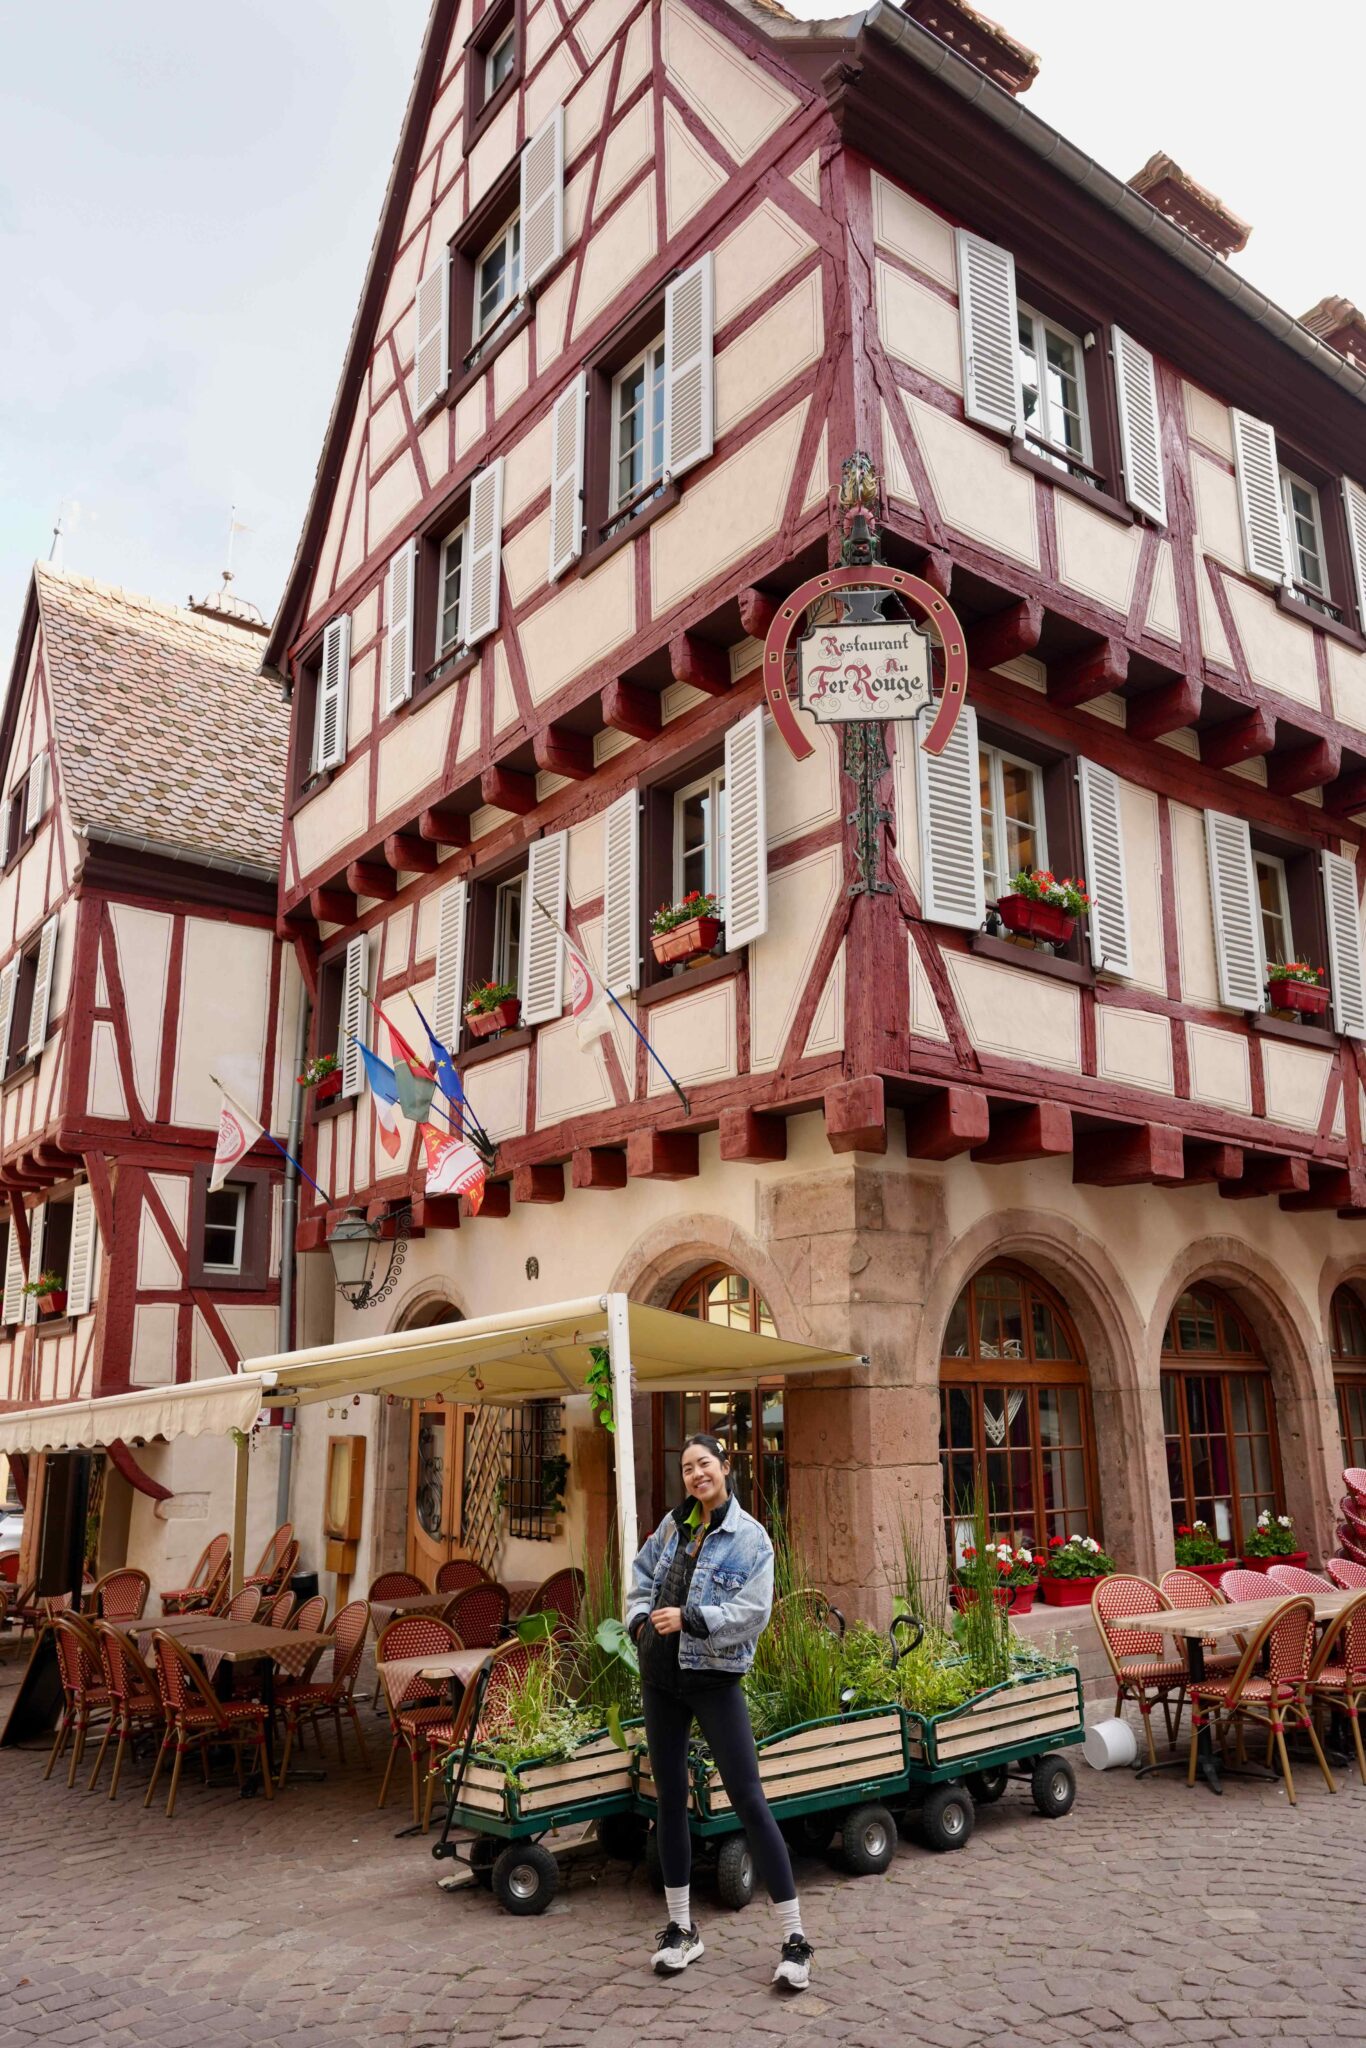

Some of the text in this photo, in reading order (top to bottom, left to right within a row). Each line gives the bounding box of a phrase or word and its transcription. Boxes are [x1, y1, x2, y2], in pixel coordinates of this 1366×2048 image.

[820, 632, 911, 656] Restaurant
[884, 657, 908, 673] Au
[807, 660, 924, 704] Fer Rouge
